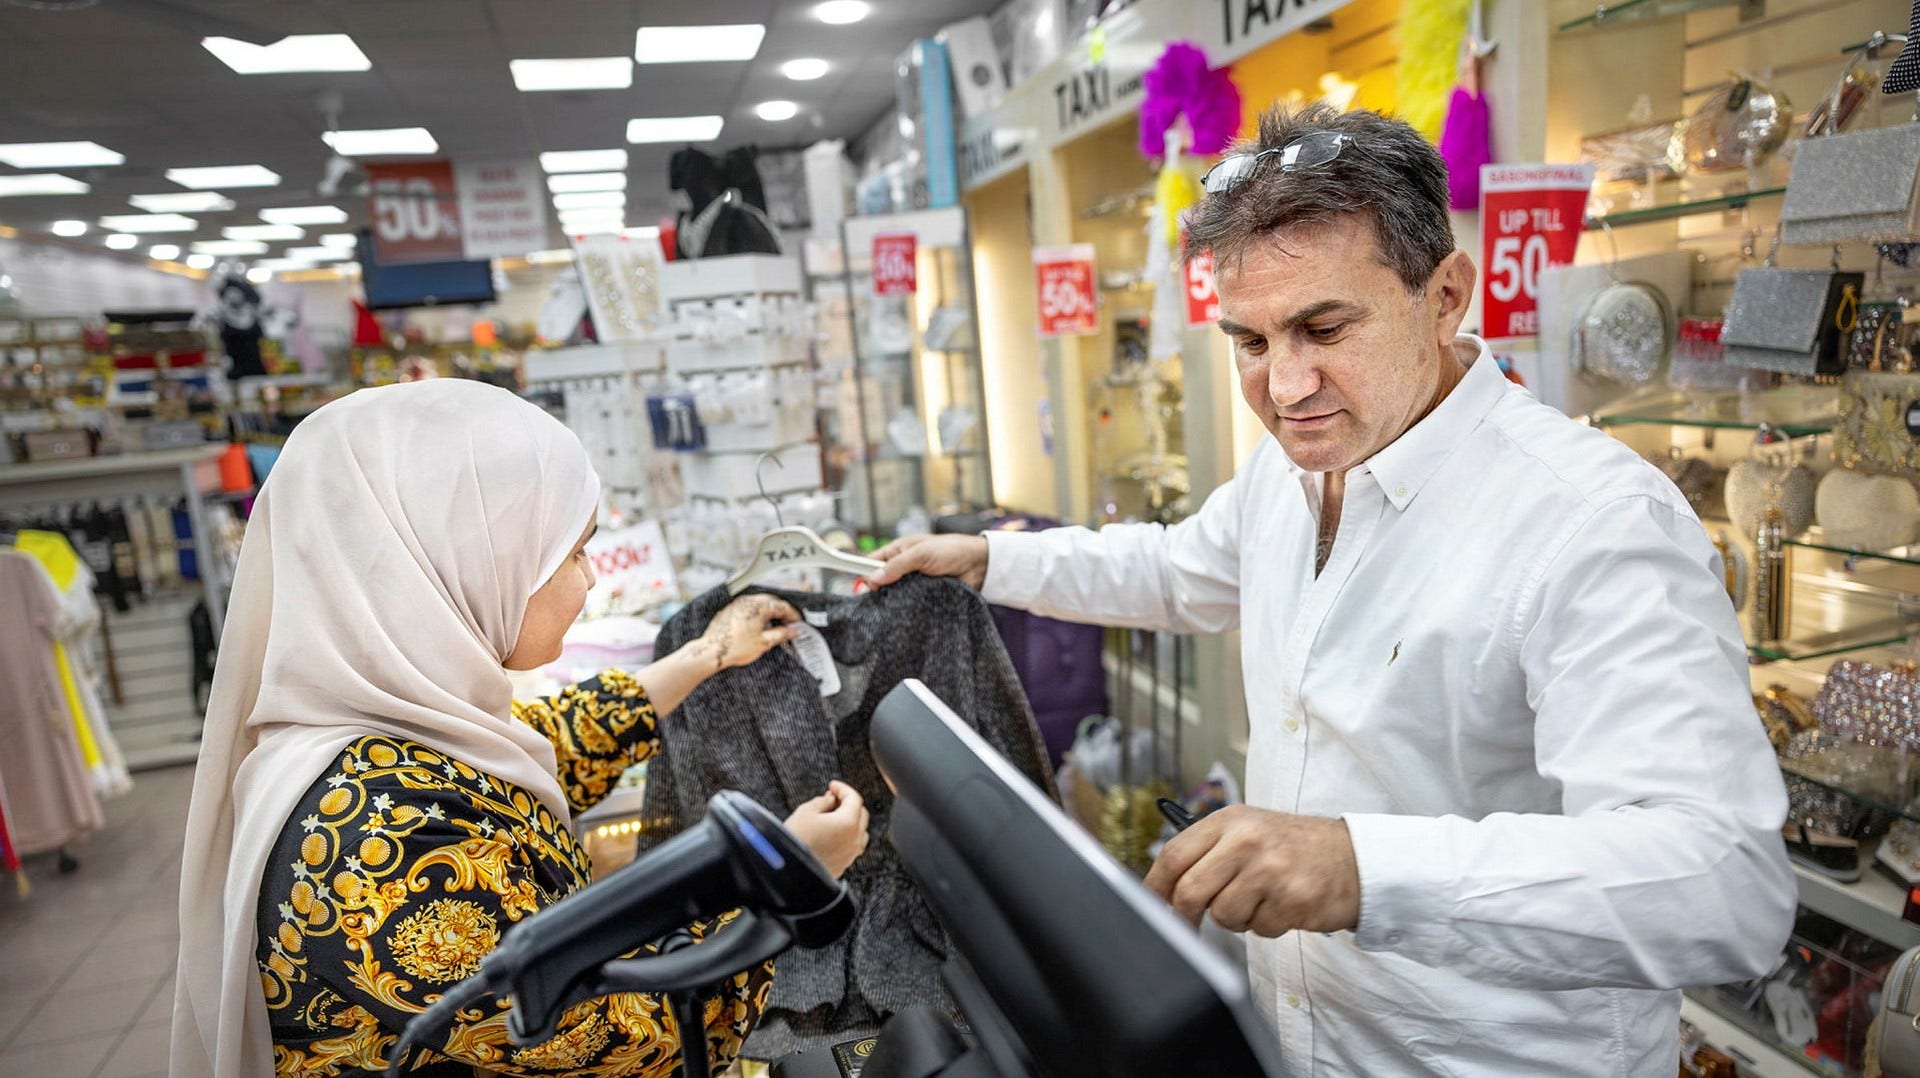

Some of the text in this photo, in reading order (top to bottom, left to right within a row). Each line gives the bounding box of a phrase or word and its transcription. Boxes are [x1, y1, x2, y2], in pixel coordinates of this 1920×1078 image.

[1221, 0, 1317, 45] TA
[1054, 66, 1110, 130] TAXI
[1499, 208, 1565, 233] UP TILL
[1489, 234, 1563, 302] 50
[1043, 281, 1095, 316] 50%
[1509, 311, 1537, 335] RE
[764, 545, 816, 562] TAXI
